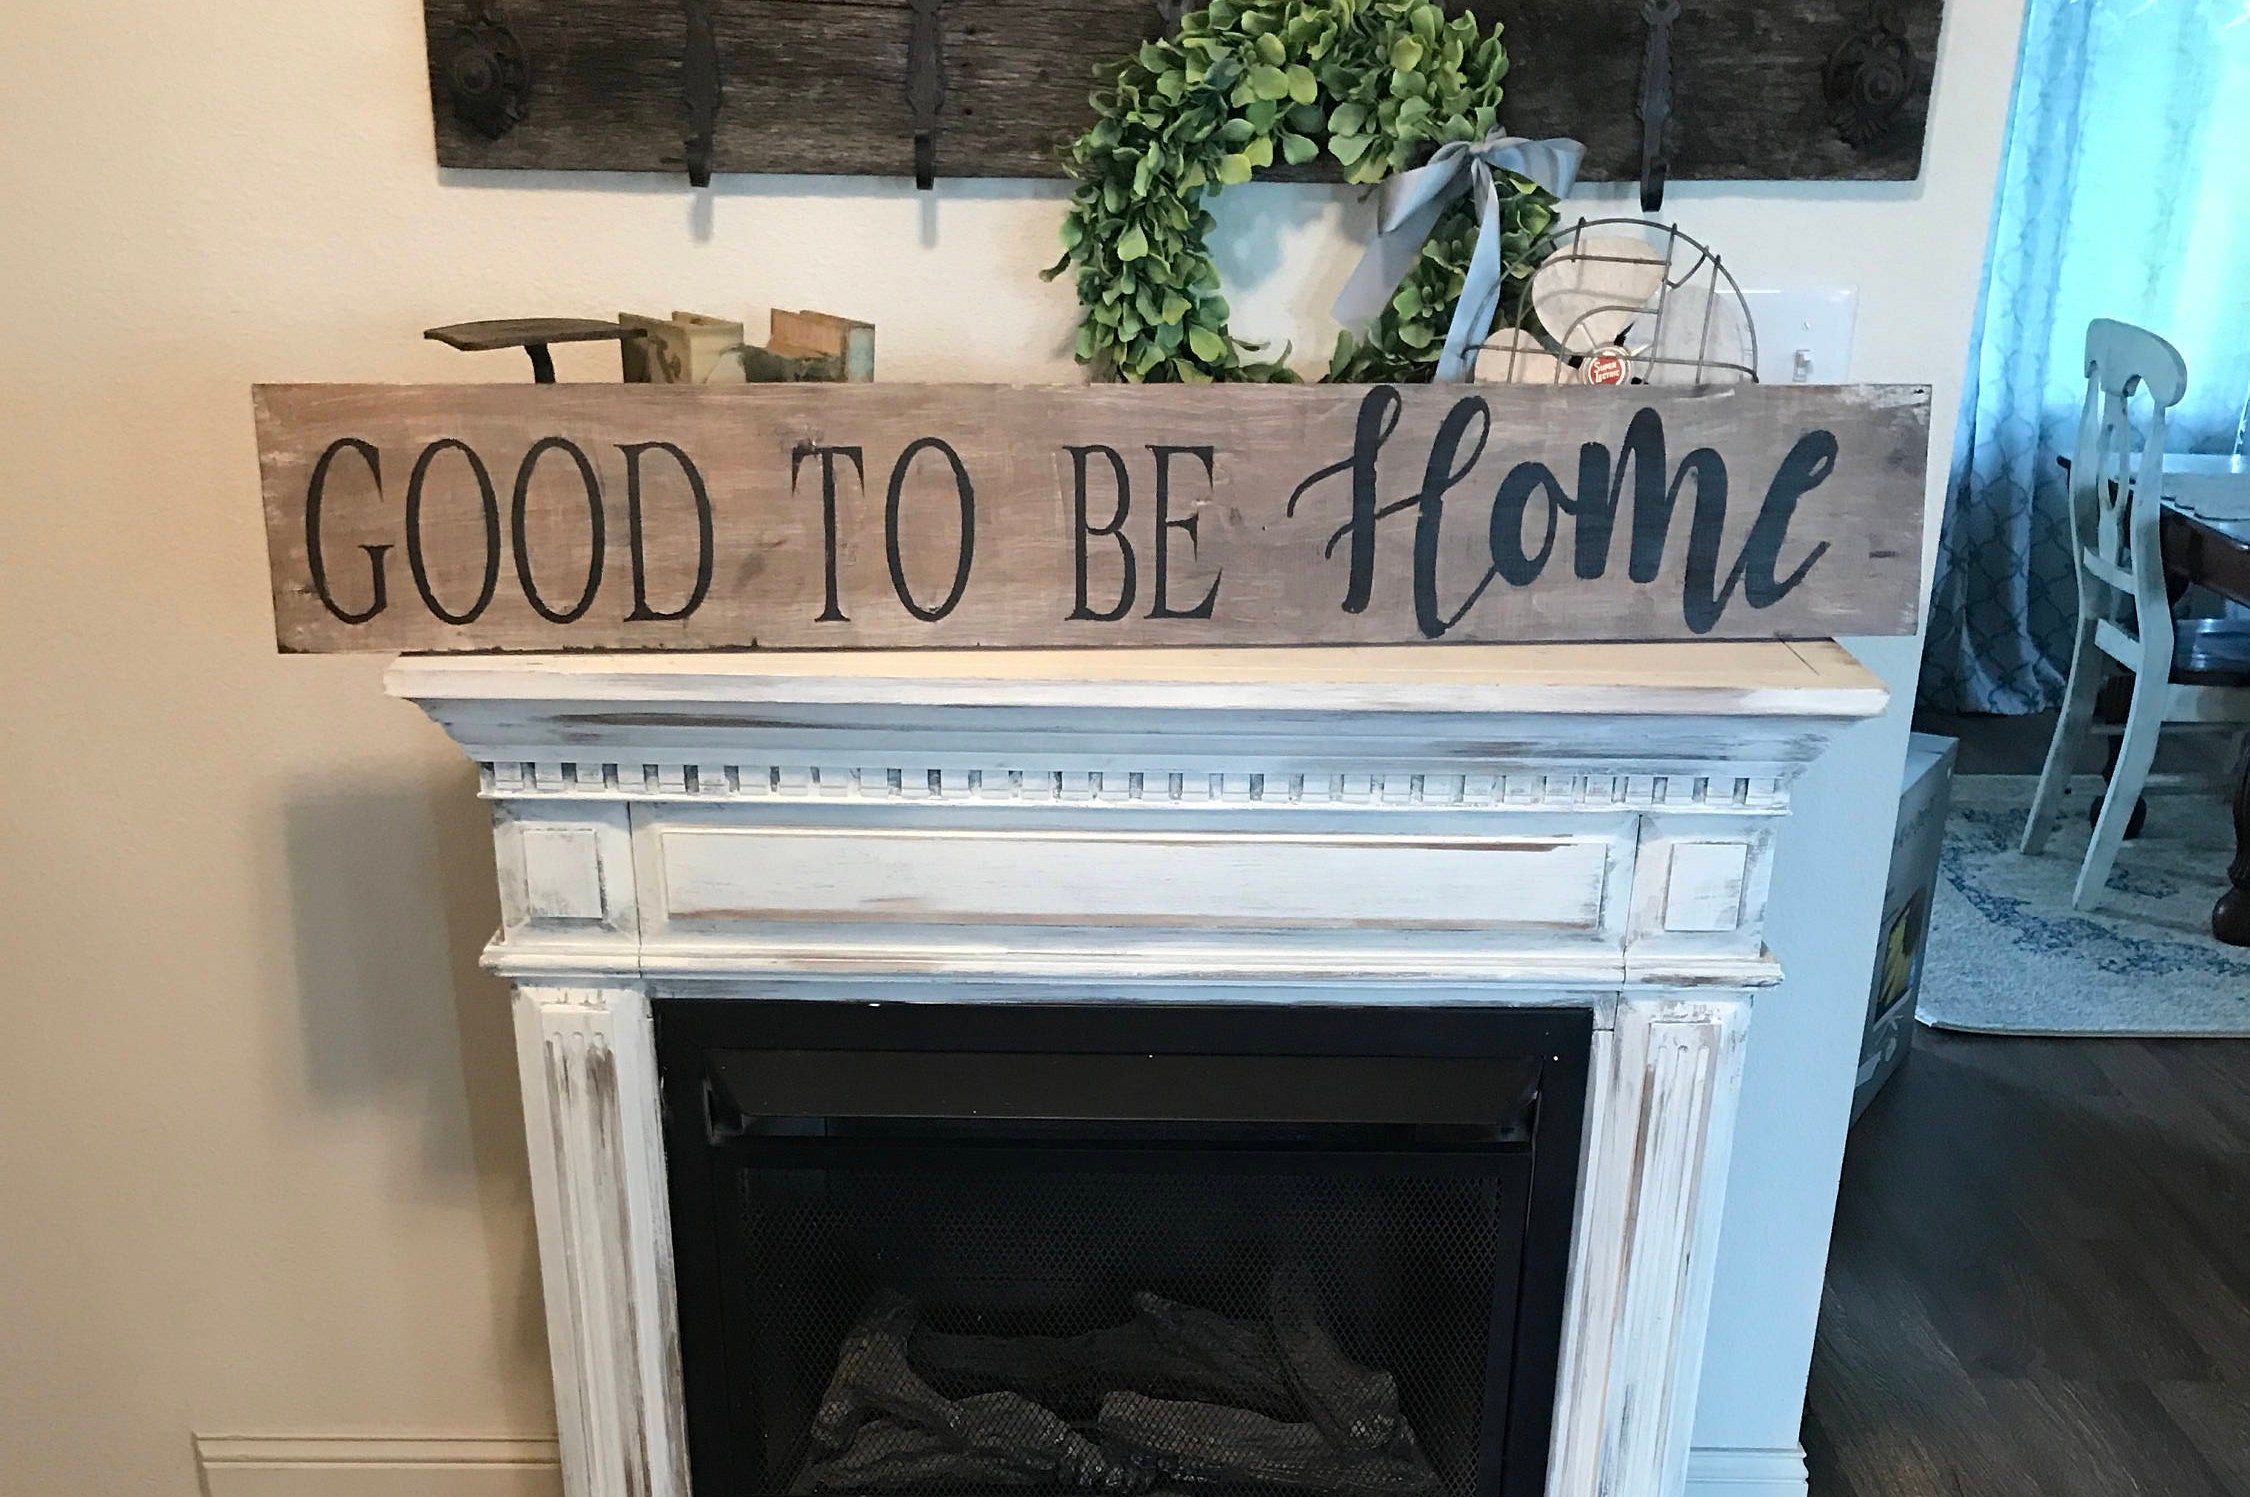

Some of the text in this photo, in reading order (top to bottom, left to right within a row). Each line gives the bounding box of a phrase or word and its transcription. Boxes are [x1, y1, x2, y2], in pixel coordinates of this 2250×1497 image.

[305, 383, 1839, 640] GOOD TO BE Home
